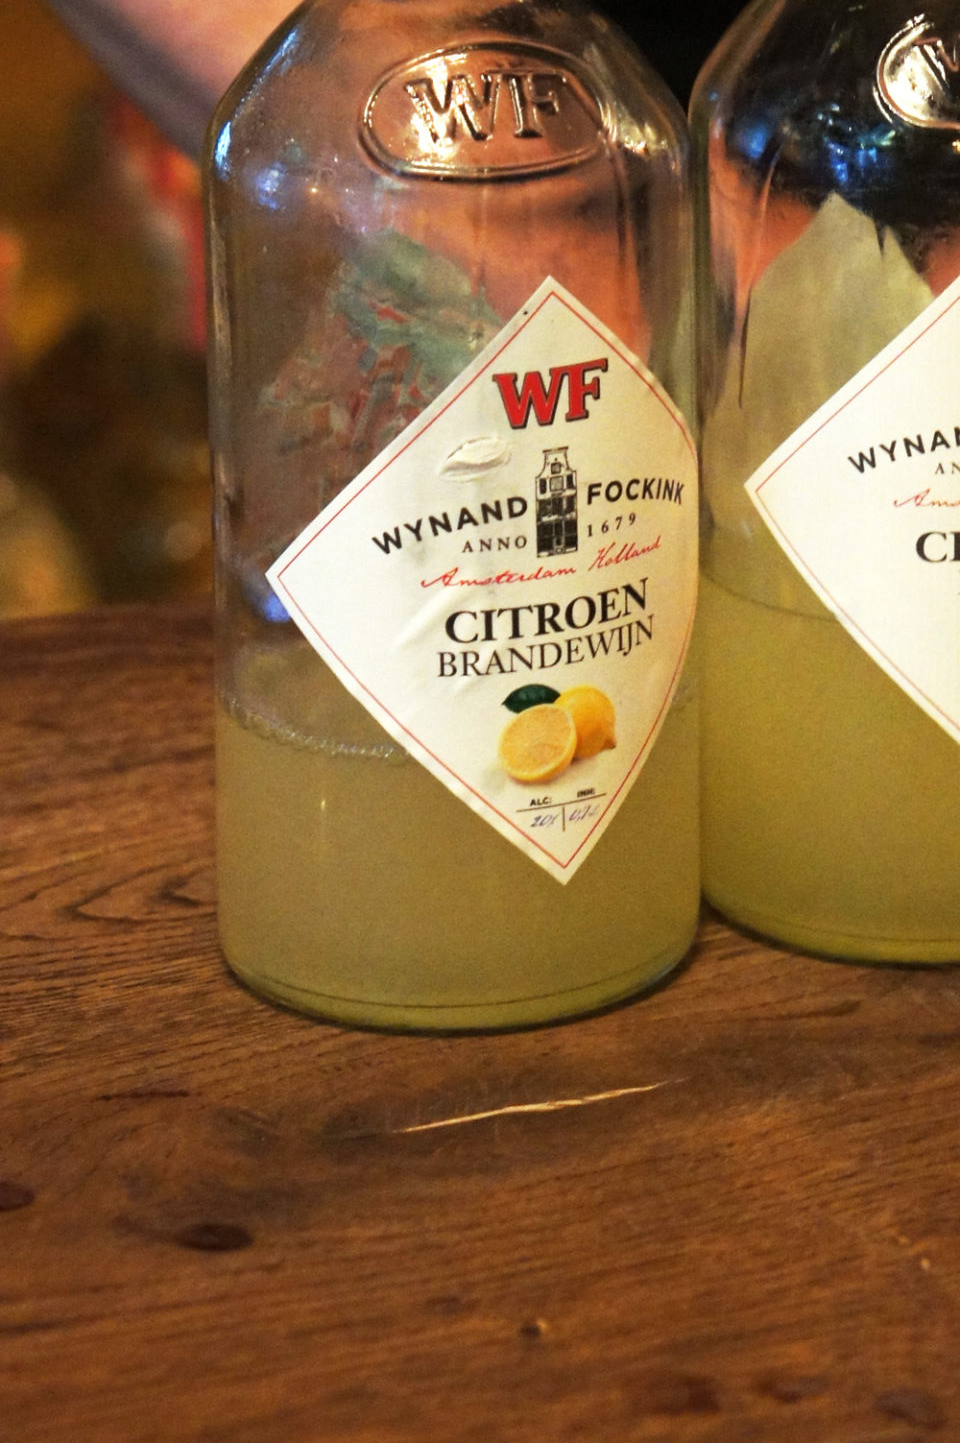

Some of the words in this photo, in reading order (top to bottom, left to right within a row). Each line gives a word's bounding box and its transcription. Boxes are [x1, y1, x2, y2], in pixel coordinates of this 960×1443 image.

[404, 67, 568, 146] WF
[492, 358, 608, 430] WF
[372, 496, 528, 555] WYNAND
[586, 478, 685, 506] FOCKINK
[462, 536, 528, 553] ANNO
[586, 512, 637, 538] 1679
[420, 566, 577, 588] Amsterdam
[588, 535, 662, 571] Holland
[445, 577, 649, 644] CITROEN
[437, 614, 655, 678] BRANDEWIJN
